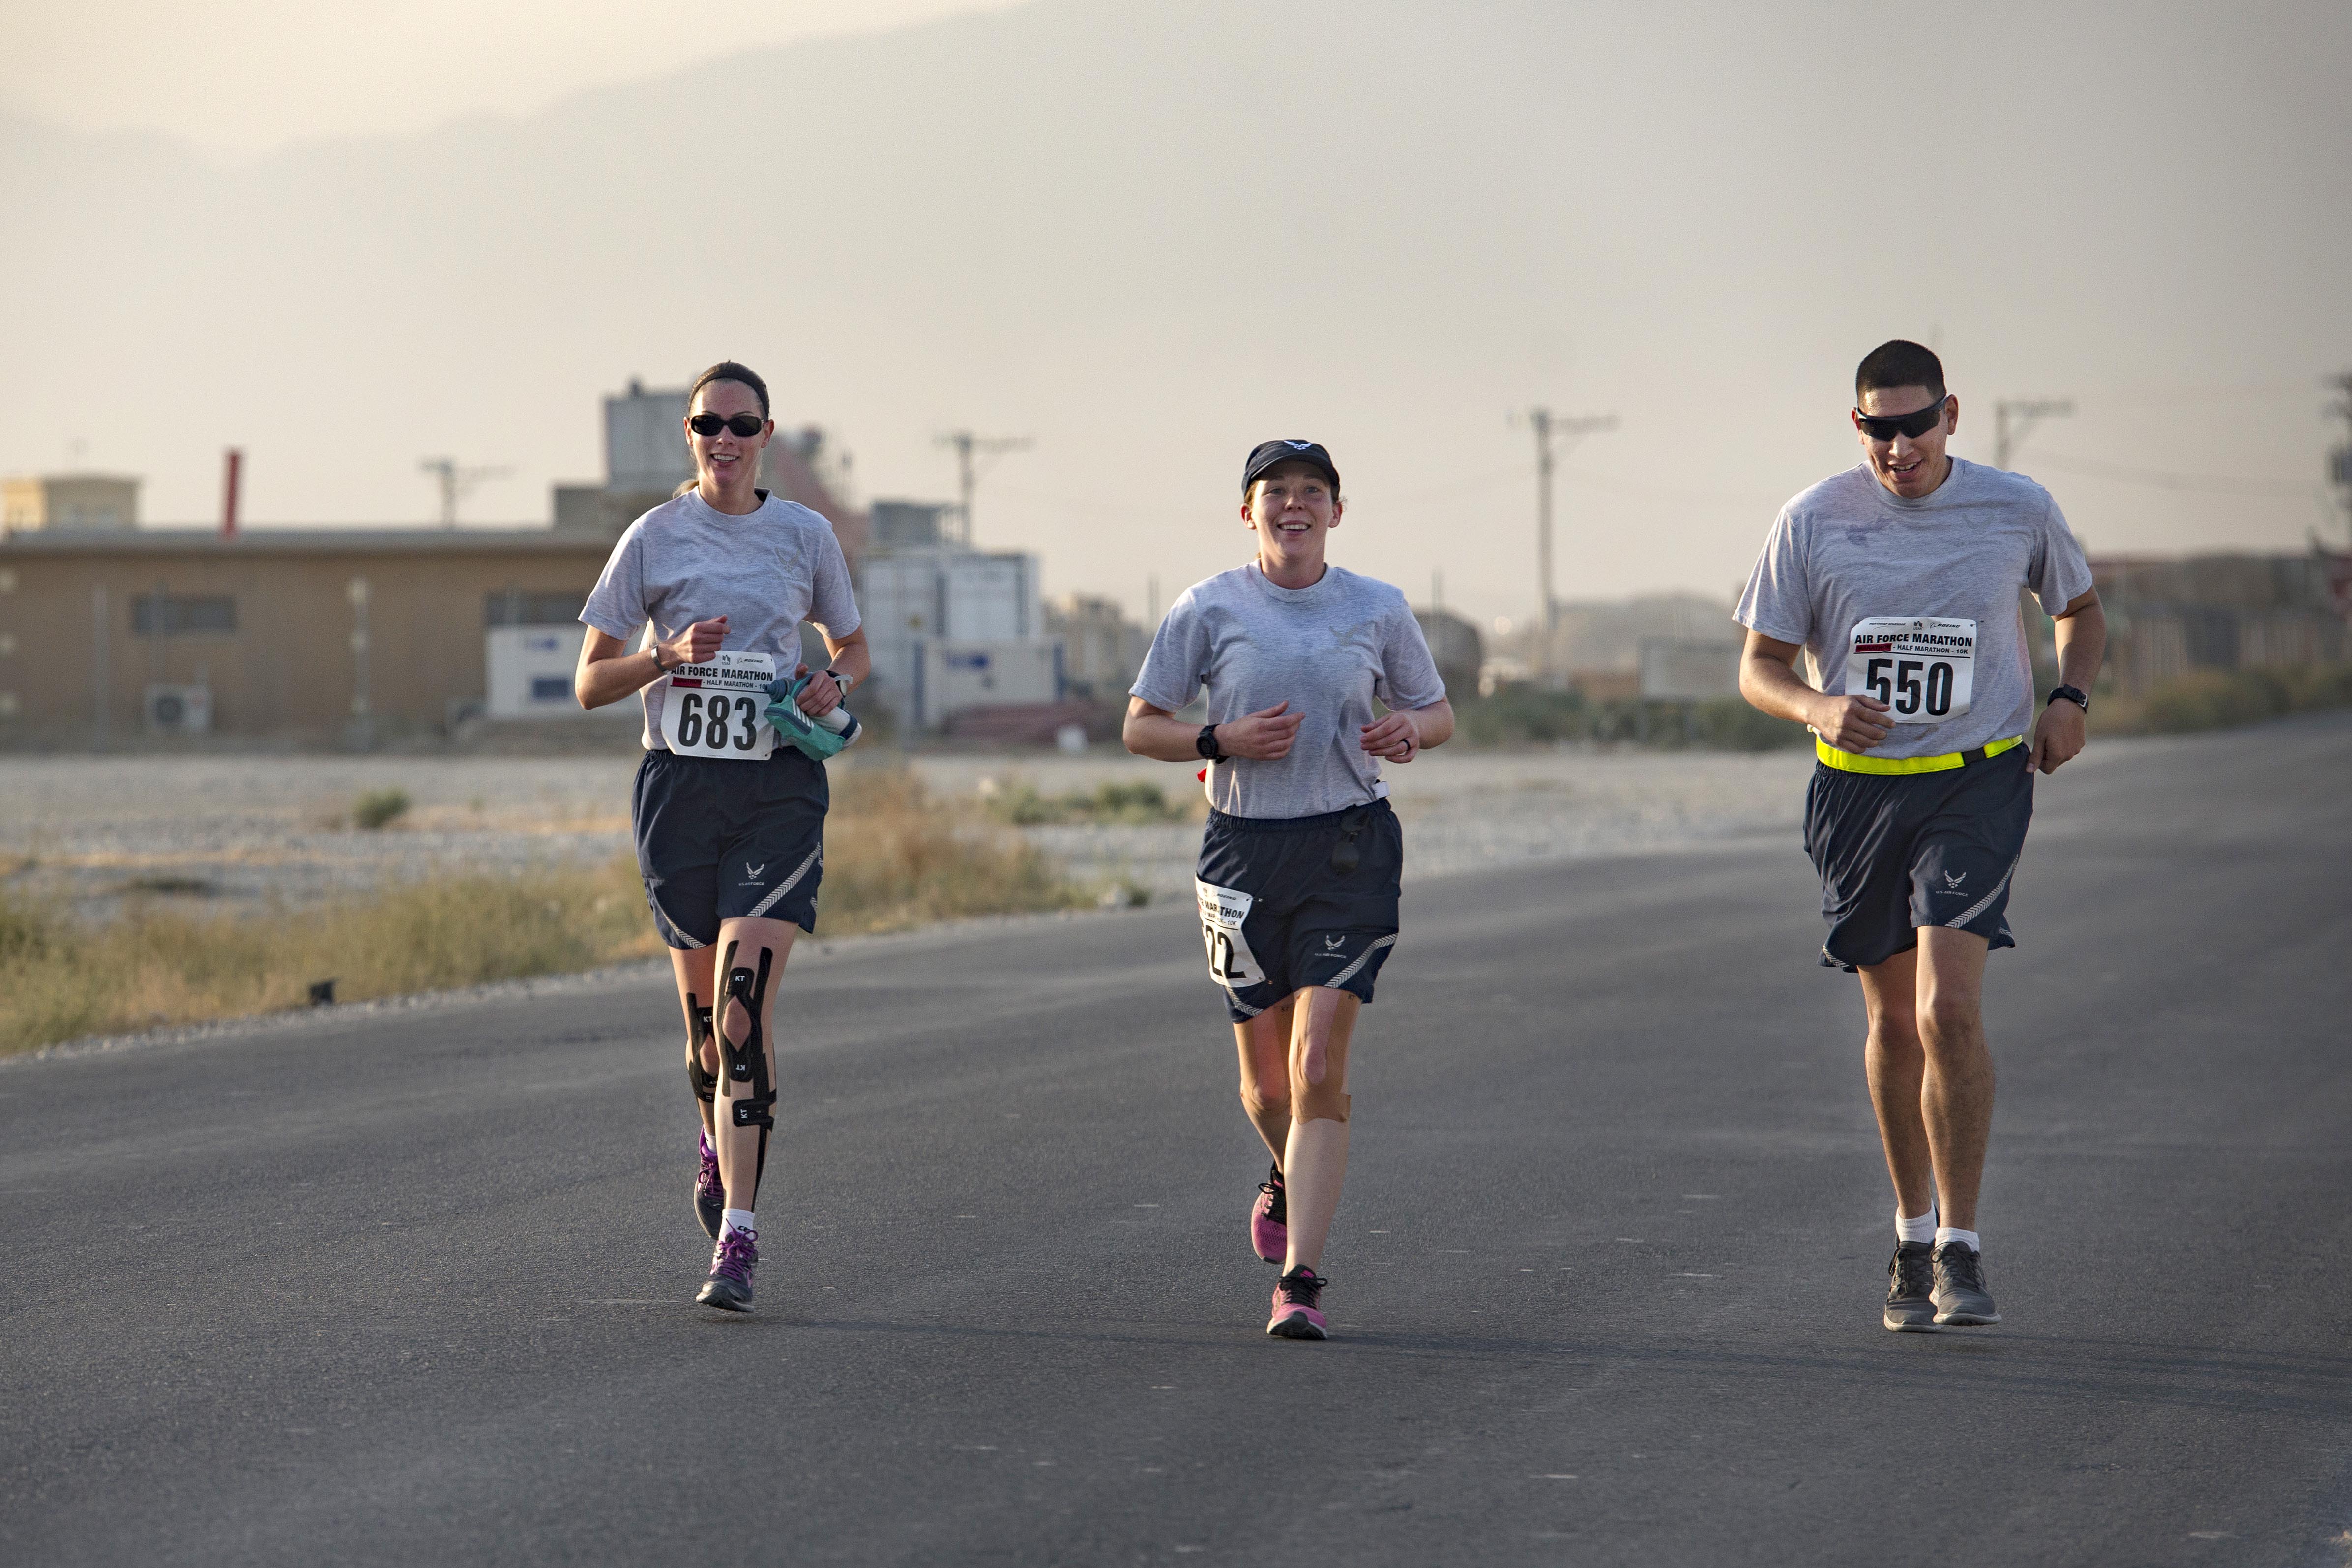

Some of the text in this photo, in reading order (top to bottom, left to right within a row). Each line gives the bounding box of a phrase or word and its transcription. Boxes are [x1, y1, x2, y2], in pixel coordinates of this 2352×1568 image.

[1855, 633, 1972, 647] AIR FORCE MARATHON
[1915, 645, 1950, 653] MARATHON
[671, 666, 773, 681] AIR FORCE MARATHON
[1866, 658, 1954, 716] 550
[678, 693, 757, 751] 683
[740, 1109, 748, 1119] KT
